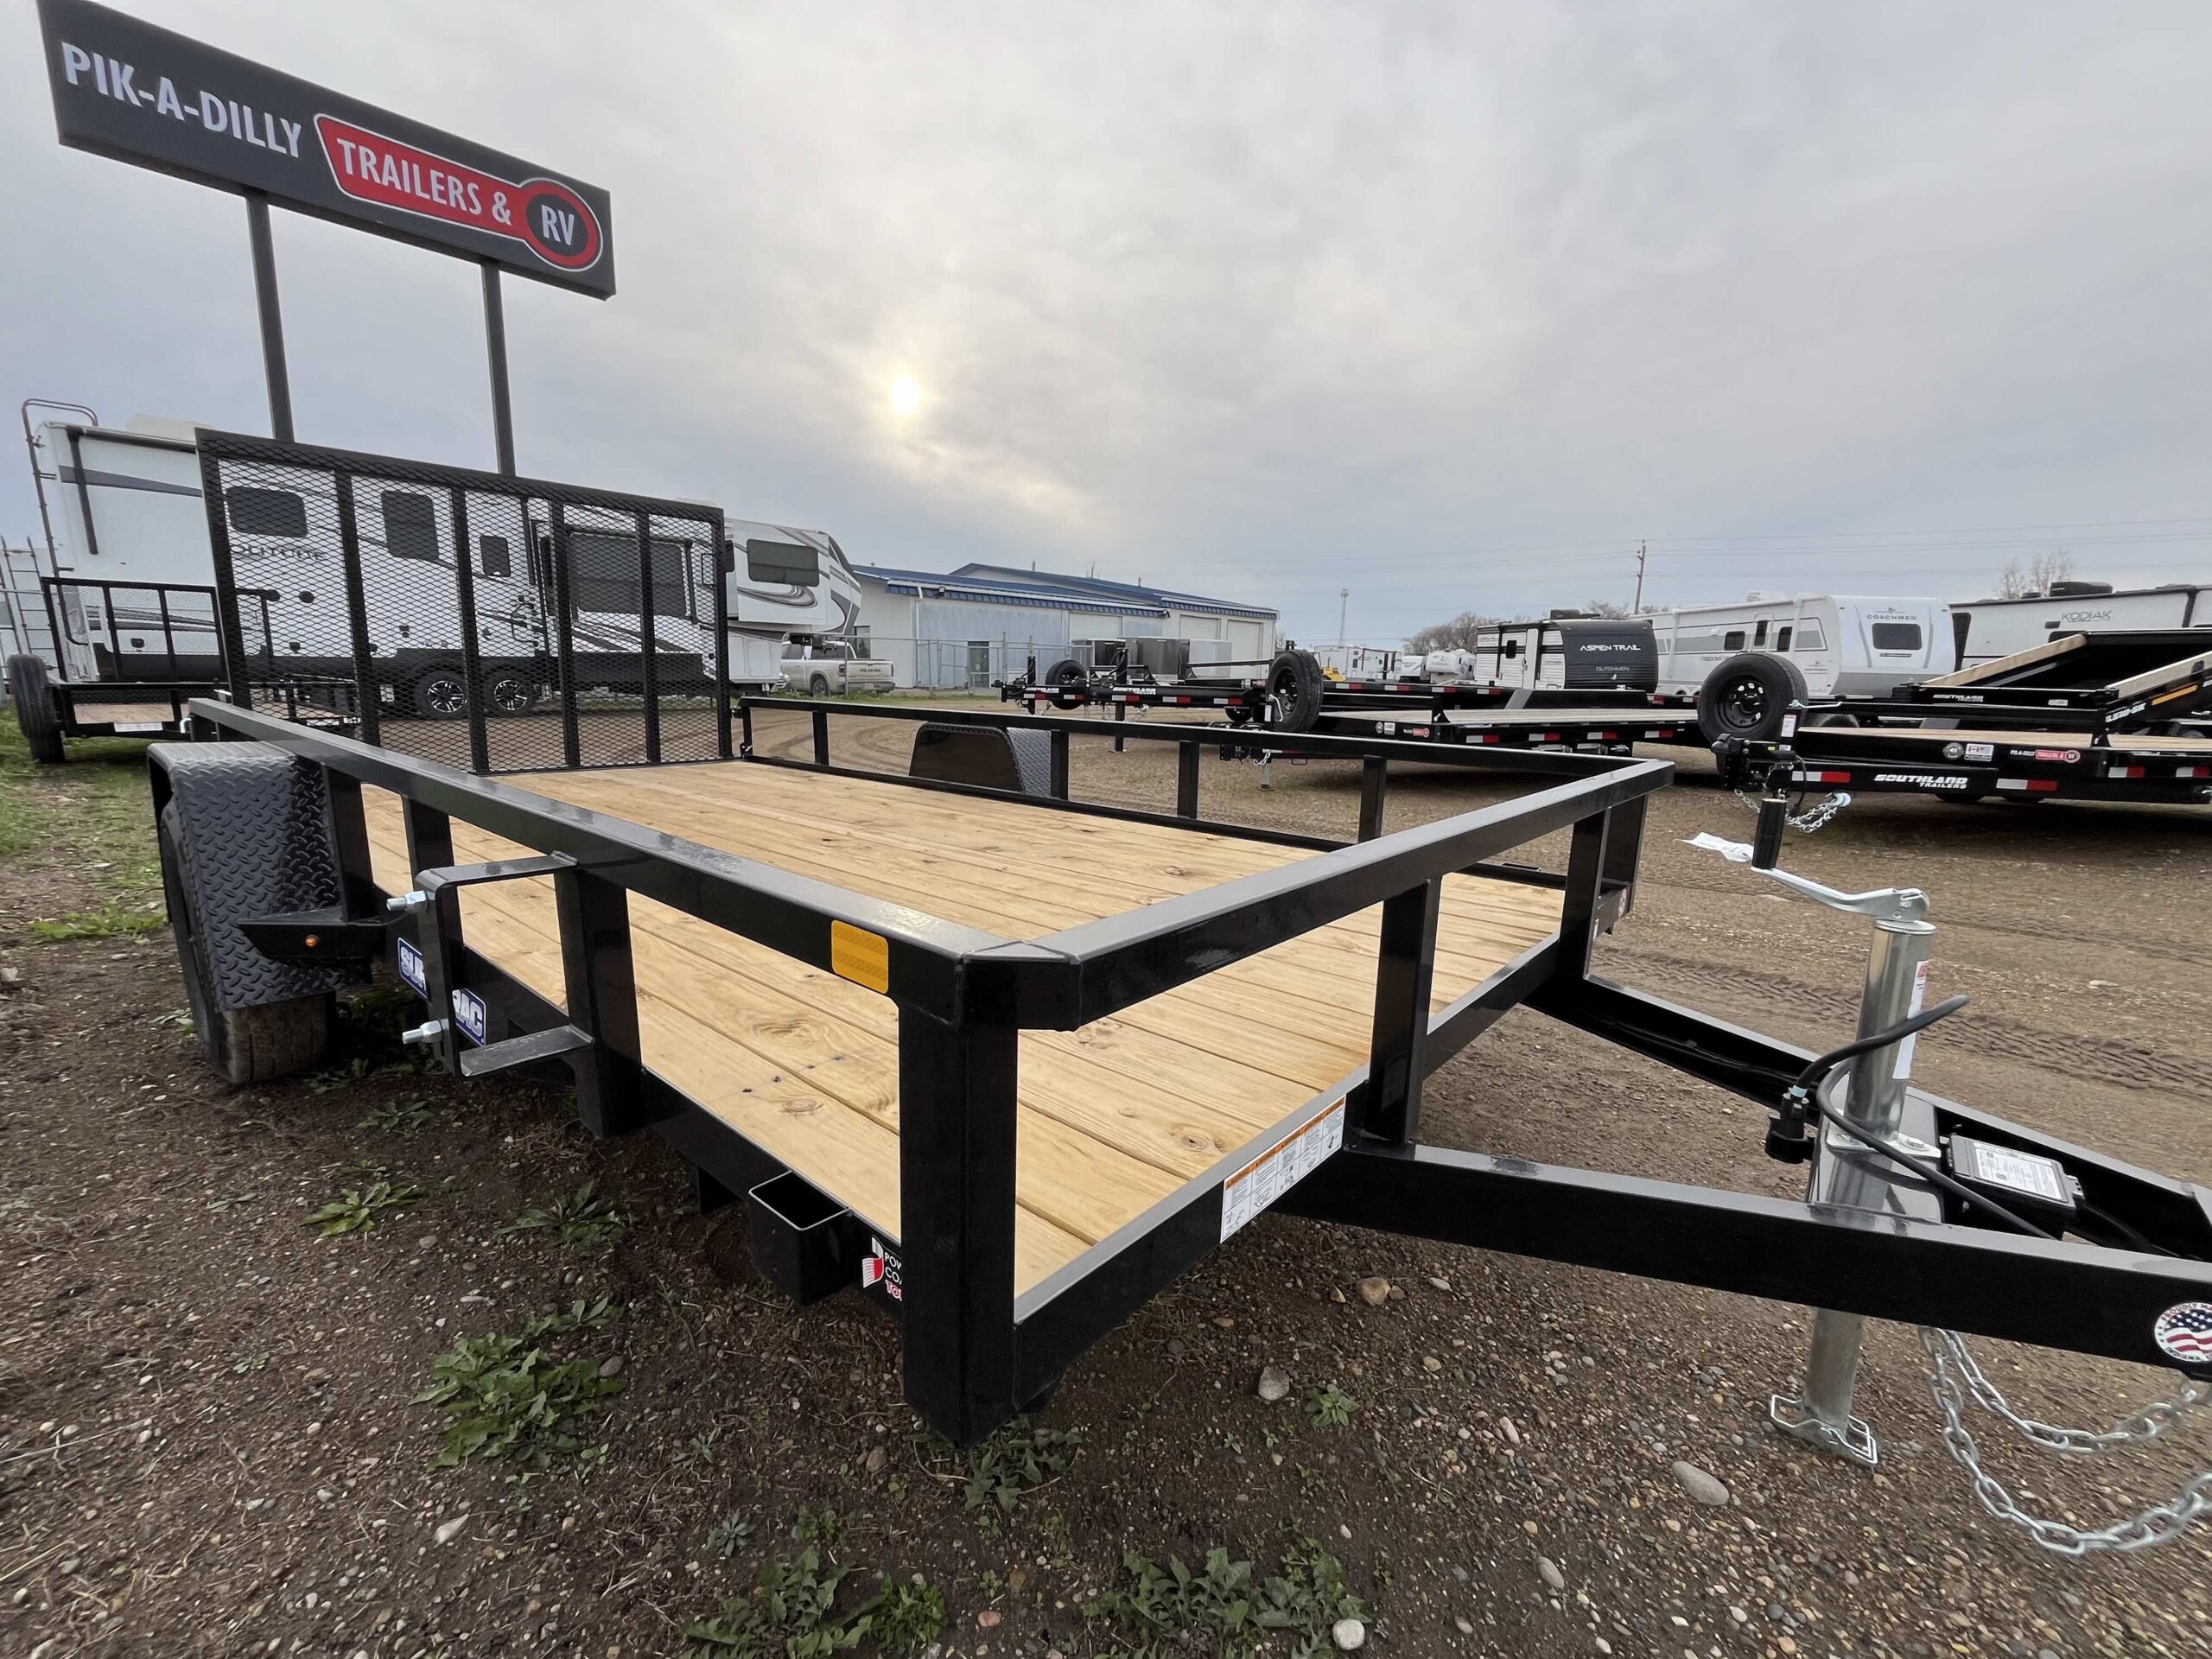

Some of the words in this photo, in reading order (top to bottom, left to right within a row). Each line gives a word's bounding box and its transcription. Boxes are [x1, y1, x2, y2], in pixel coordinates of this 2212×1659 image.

[61, 41, 302, 158] PIK-A-DILLY
[337, 138, 481, 215] TRAILERS
[492, 191, 512, 226] &
[541, 204, 575, 246] RV
[2061, 610, 2113, 621] KODIAK
[1874, 773, 1968, 785] SOUTHLAND
